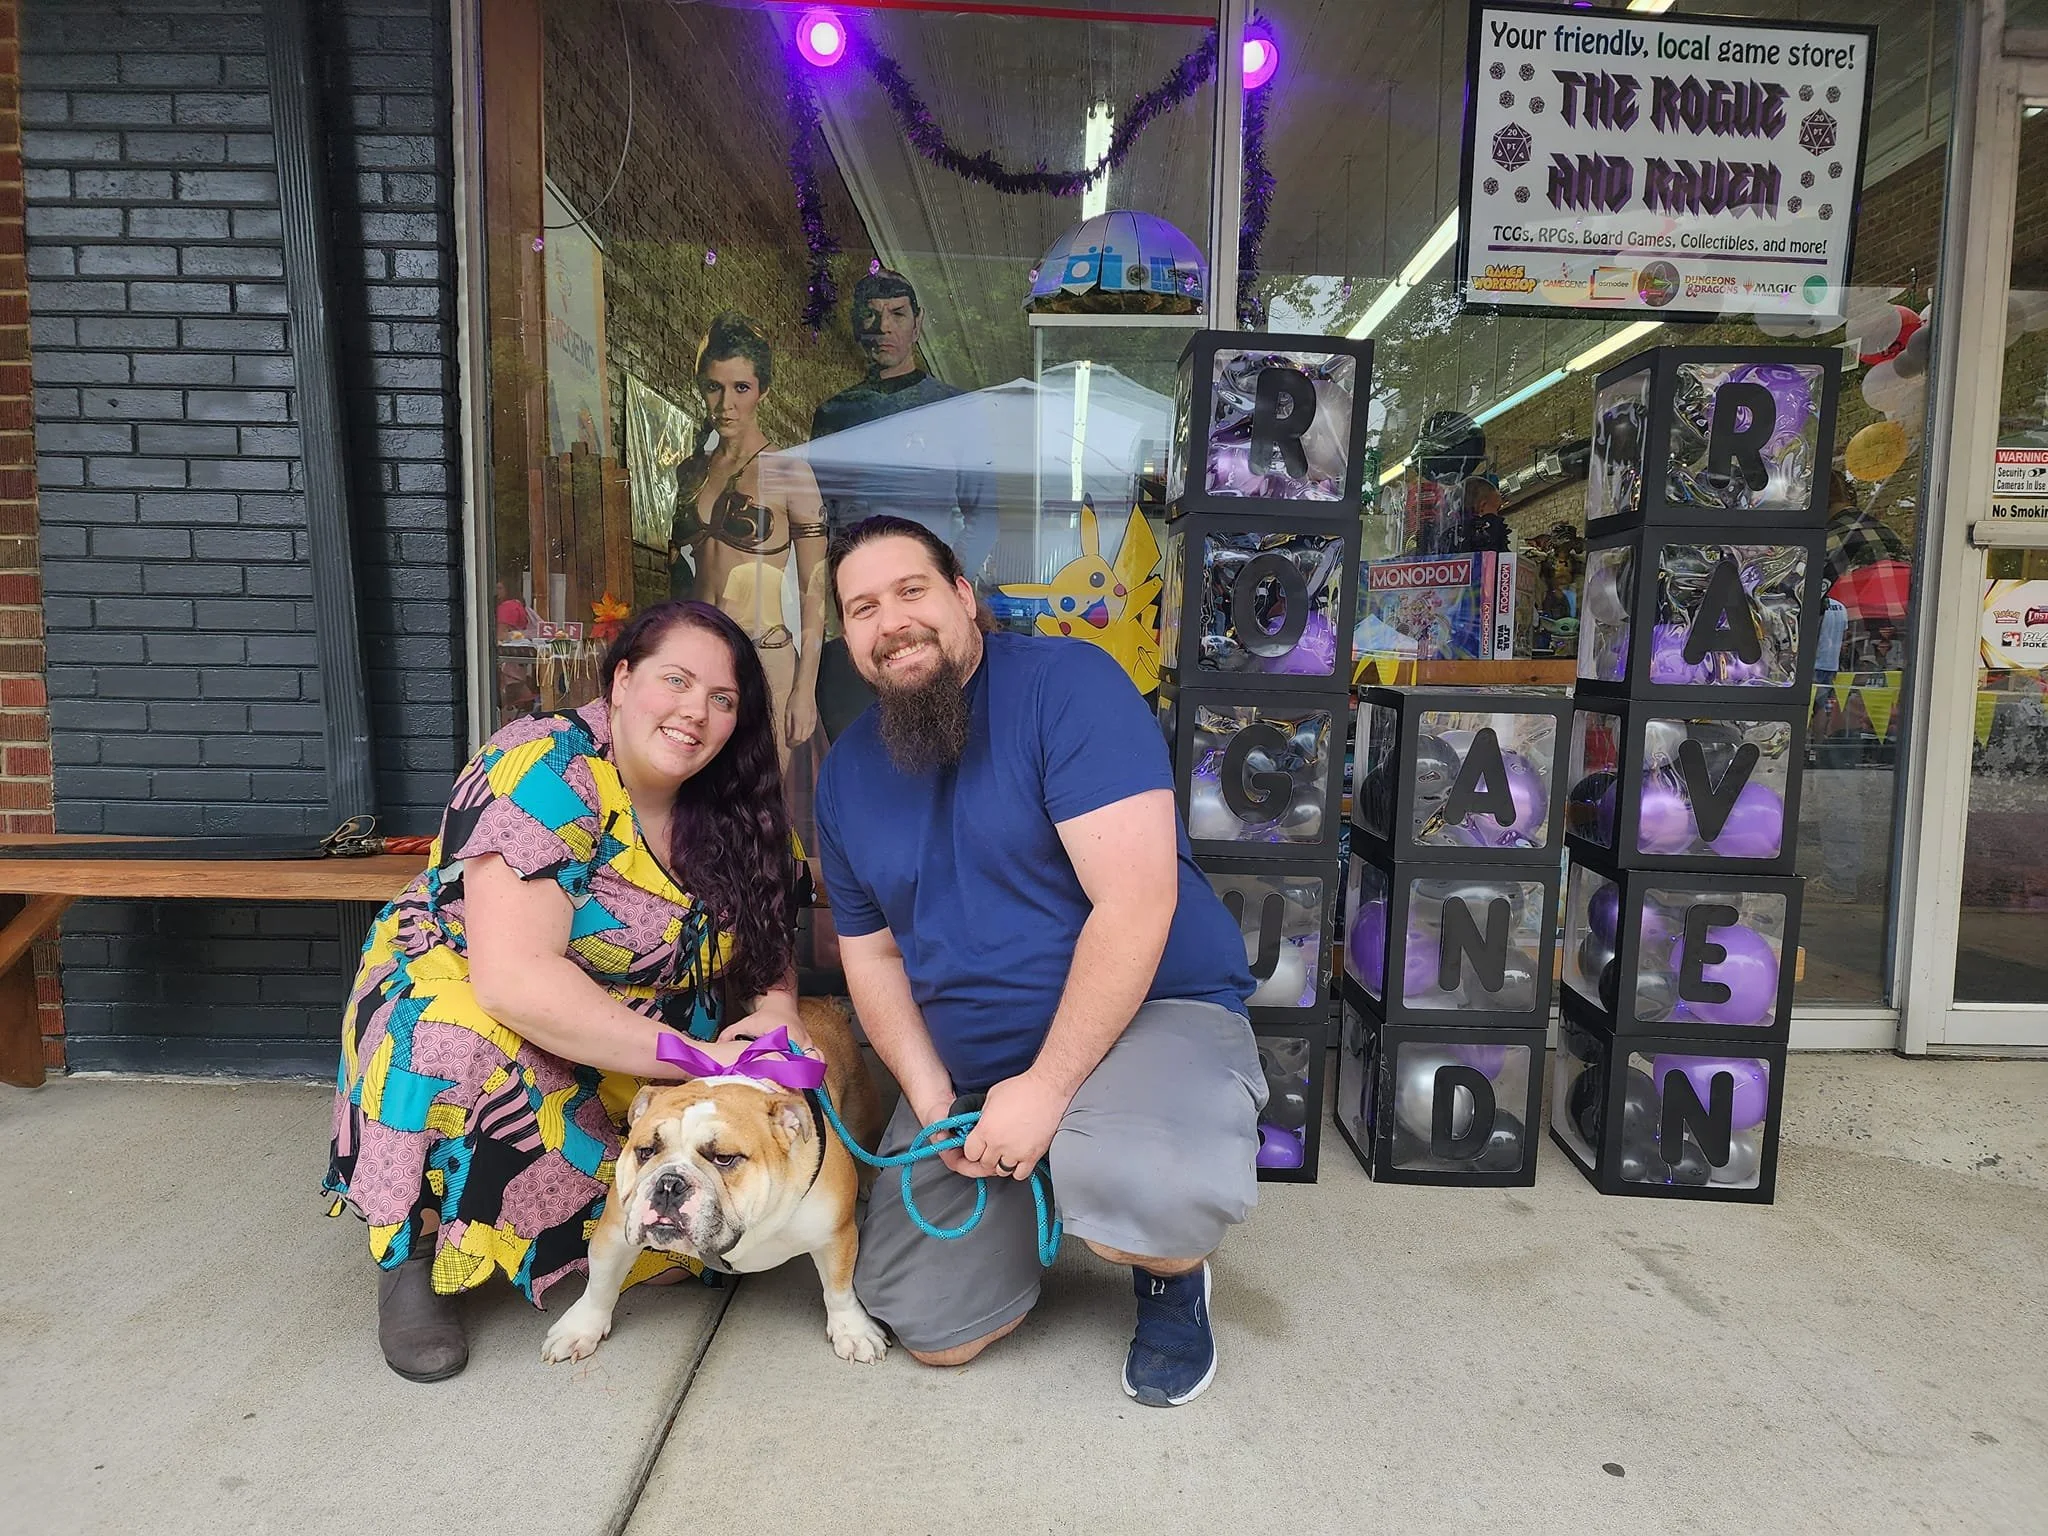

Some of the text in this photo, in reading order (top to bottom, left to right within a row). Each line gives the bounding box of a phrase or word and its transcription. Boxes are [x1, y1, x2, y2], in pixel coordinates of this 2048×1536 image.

[1490, 20, 1856, 70] Your friendly, local game store!
[1551, 68, 1791, 140] THE ROGUE
[1546, 149, 1782, 221] AND RAVEN
[1583, 229, 1623, 245] Board
[1763, 238, 1786, 253] and
[1790, 239, 1827, 254] more!
[1485, 263, 1526, 278] GAMES
[1471, 276, 1537, 294] WORKSHOP
[1543, 279, 1588, 289] GAMEGENIC
[1685, 275, 1736, 286] DUNGEONS
[1754, 283, 1797, 294] MAGIC
[1998, 451, 2048, 463] WARNING
[1997, 467, 2026, 479] Security
[1997, 480, 2046, 490] Cameras In Use
[1992, 504, 2007, 518] No
[1372, 563, 1469, 588] MONOPOLY
[1499, 563, 1510, 614] MONOPOLY
[1503, 624, 1511, 651] STAR
